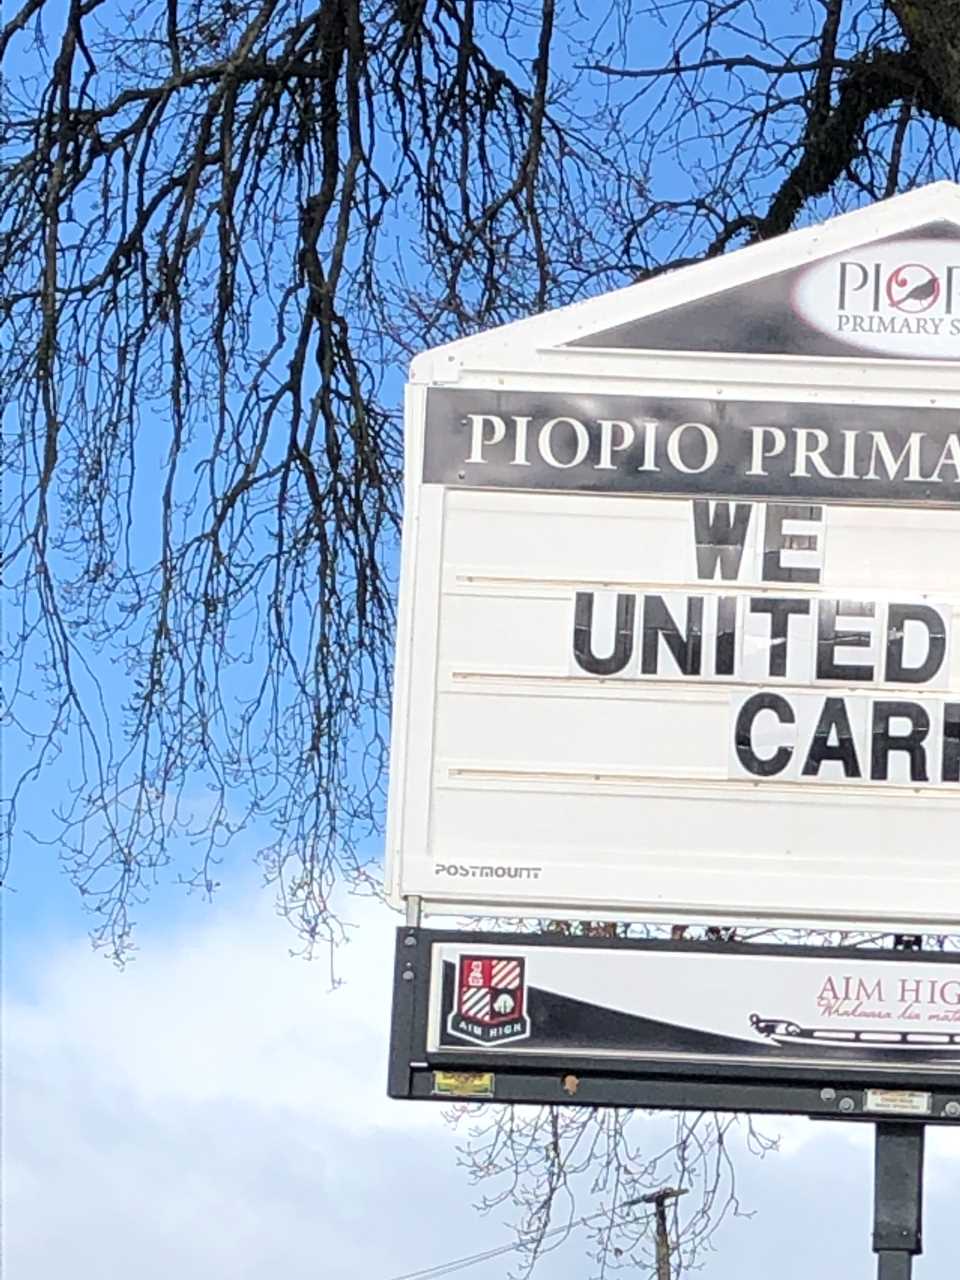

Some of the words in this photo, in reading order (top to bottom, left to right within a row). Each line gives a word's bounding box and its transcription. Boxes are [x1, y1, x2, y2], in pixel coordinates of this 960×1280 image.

[837, 314, 944, 335] PRIMARY
[464, 413, 719, 475] PIOPIO
[692, 499, 824, 585] WE
[573, 591, 947, 684] UNITED
[434, 863, 543, 879] POSTMOUNT
[817, 975, 885, 1001] AIM
[459, 1020, 482, 1035] AIM
[489, 1022, 522, 1037] HIGH
